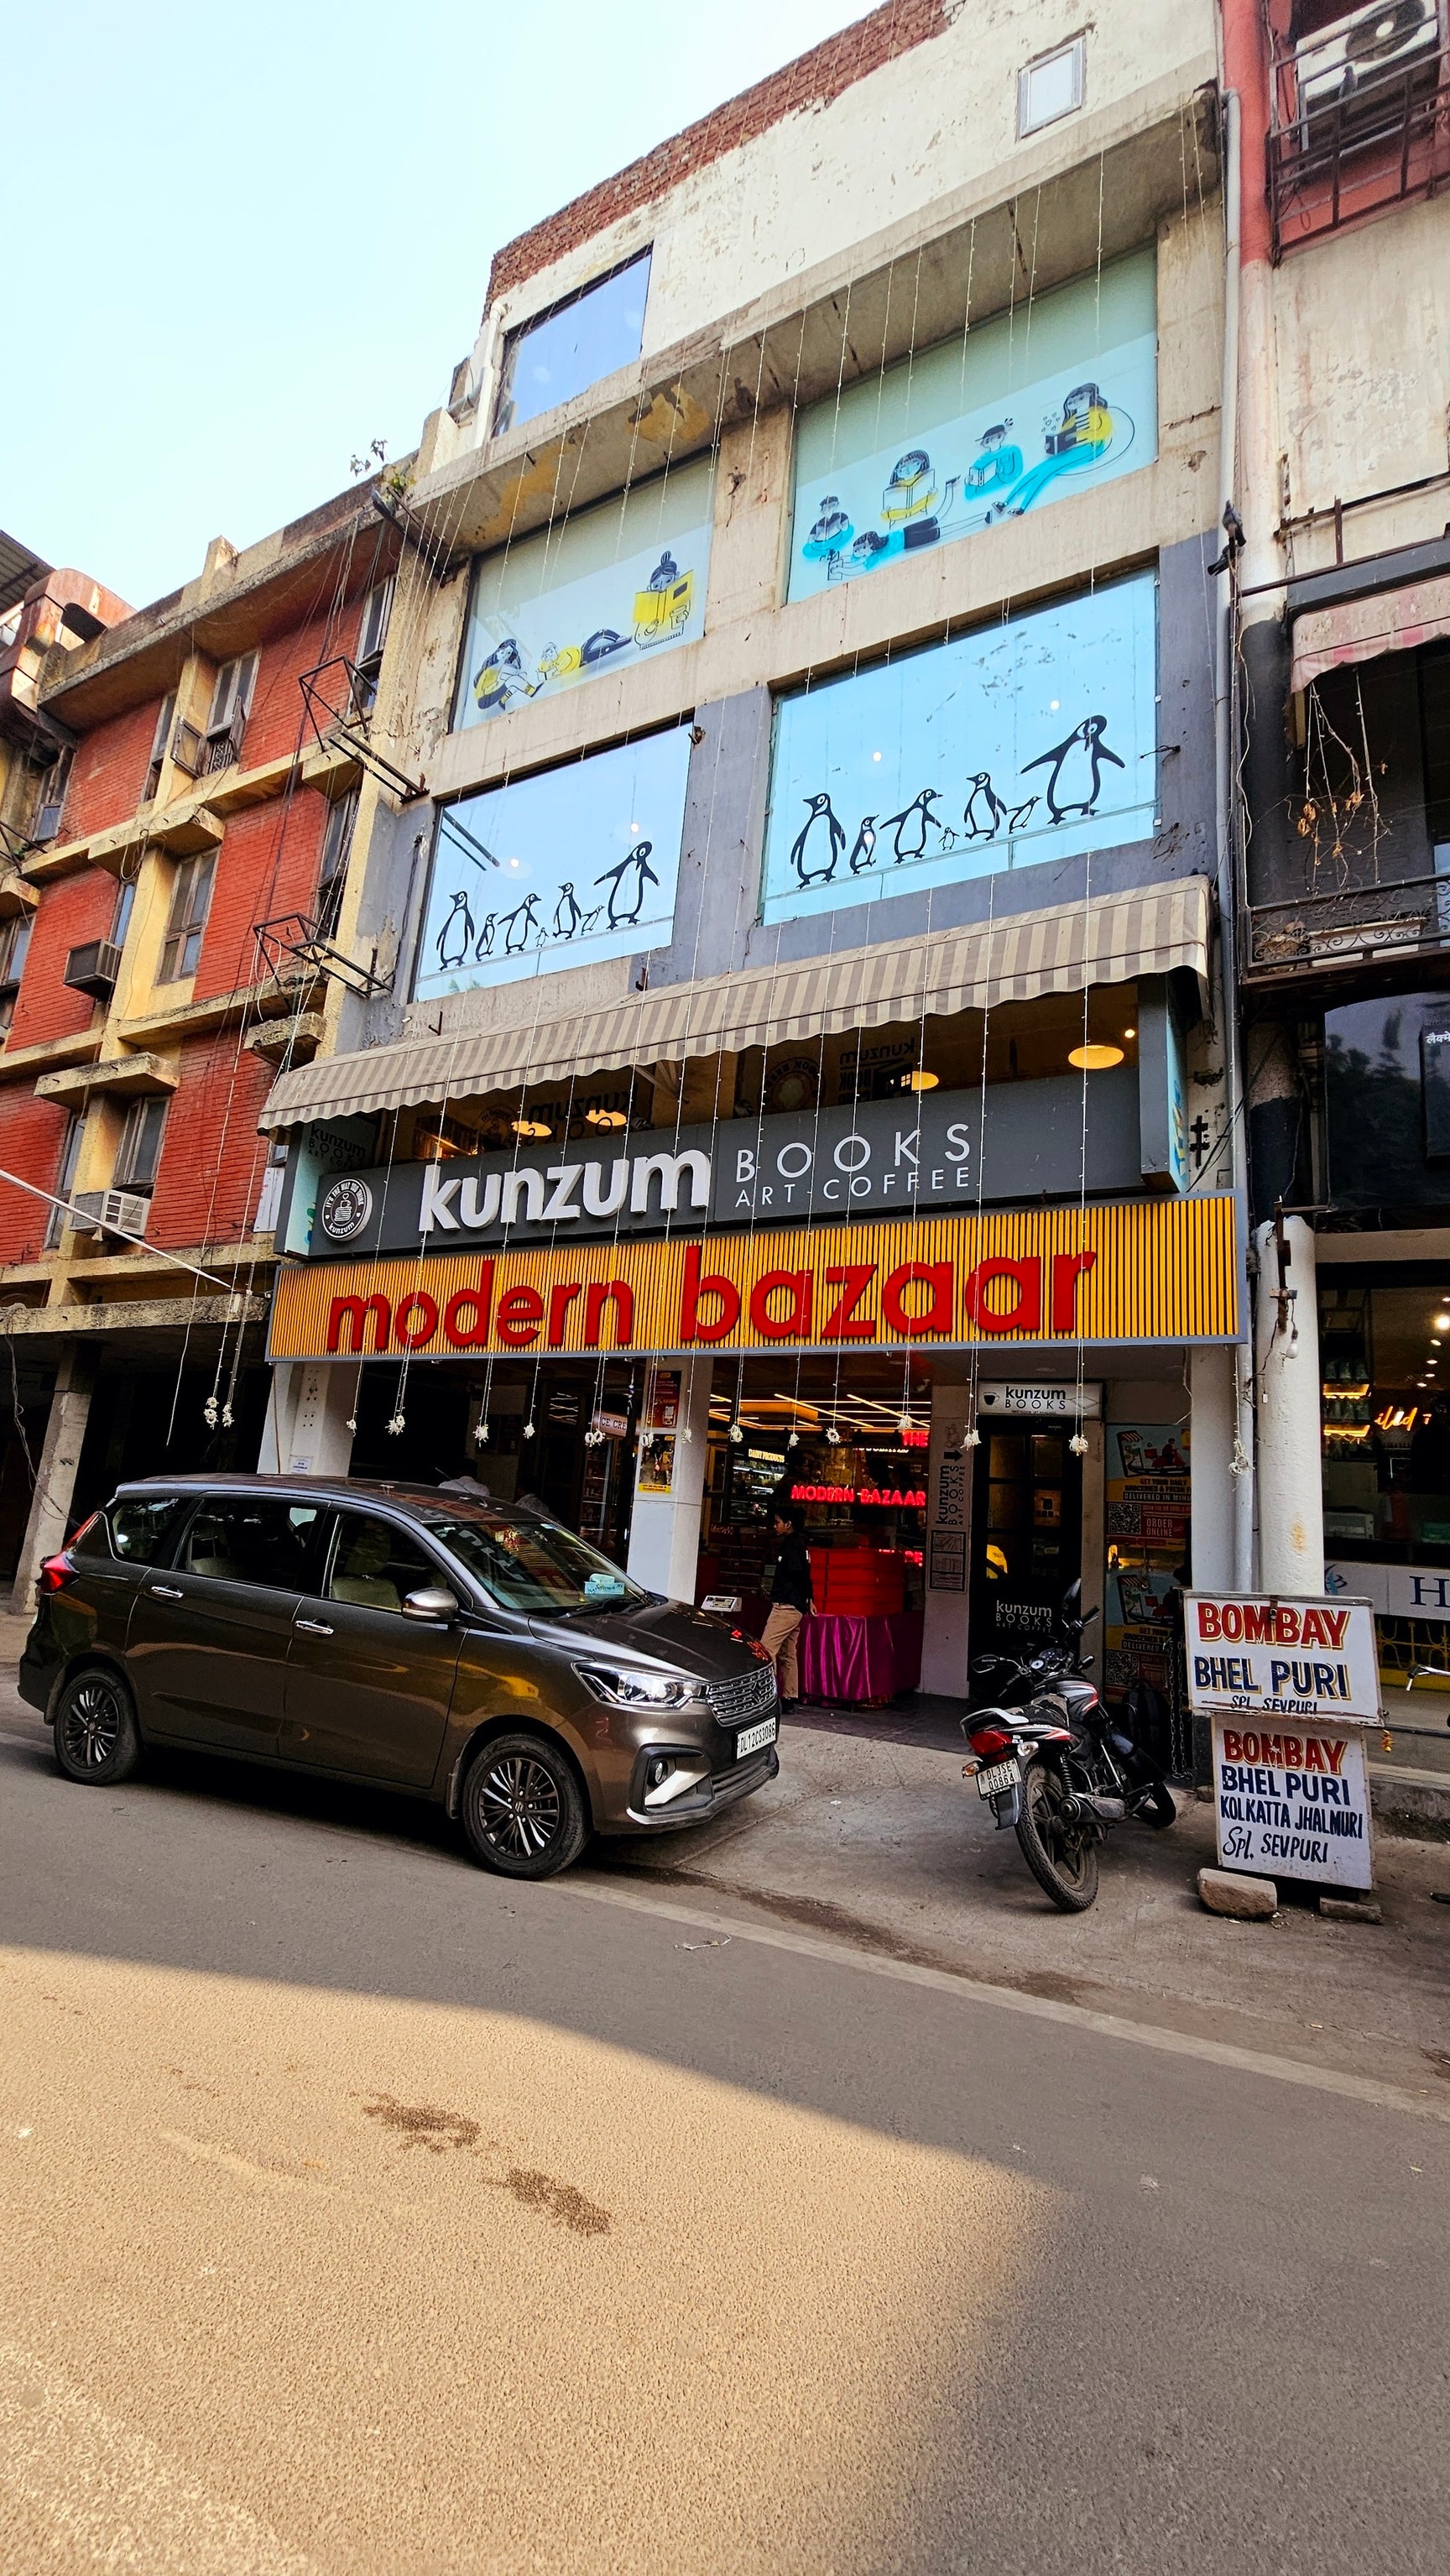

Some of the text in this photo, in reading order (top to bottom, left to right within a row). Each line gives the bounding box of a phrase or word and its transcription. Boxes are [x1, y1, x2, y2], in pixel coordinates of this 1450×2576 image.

[310, 1122, 366, 1158] kunzum
[736, 1124, 970, 1183] BOOKS
[419, 1148, 712, 1232] kunzum
[735, 1167, 969, 1208] ART COFFEE
[328, 1221, 355, 1235] kunzum
[326, 1246, 1097, 1352] modern bazaar
[1004, 1399, 1066, 1410] BOOKS
[1005, 1386, 1066, 1400] kunzum
[902, 1430, 929, 1447] THE
[790, 1485, 926, 1506] MODERN BAZAAR
[935, 1465, 950, 1525] kunzum
[948, 1465, 960, 1526] BOOKS
[1124, 1492, 1160, 1501] DELIVERED
[1146, 1518, 1173, 1528] ORDER
[1146, 1528, 1174, 1537] ONLINE
[995, 1612, 1052, 1628] BOOKS
[996, 1599, 1052, 1617] kunzum
[1197, 1602, 1350, 1650] BOMBAY
[1194, 1656, 1351, 1701] BHEL PURI
[1263, 1697, 1317, 1715] SEVPURI
[986, 1761, 1013, 1780] DL3SE
[1223, 1730, 1348, 1775] BOMBAY
[1221, 1764, 1351, 1806] BHEL PURI
[1220, 1795, 1364, 1840] KOLKATTA JHALMURI
[1222, 1826, 1329, 1863] Spl. SEVPURI
